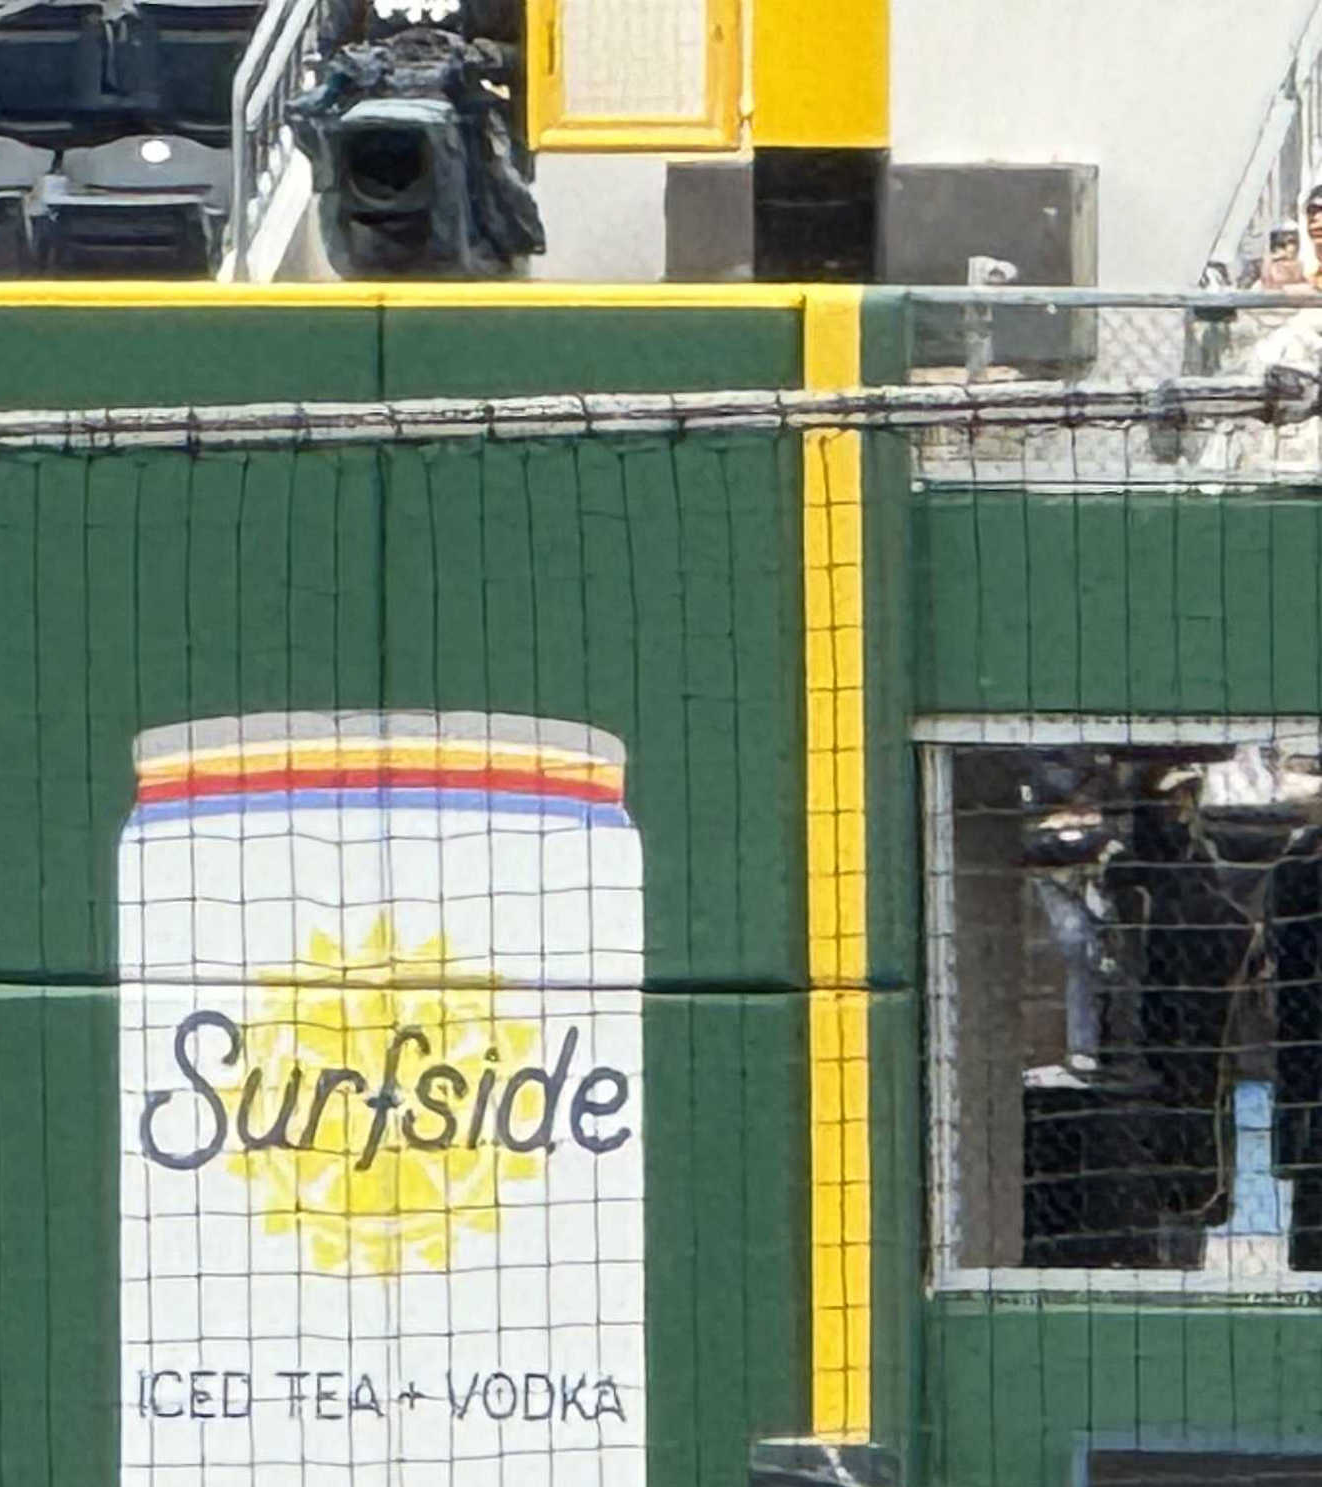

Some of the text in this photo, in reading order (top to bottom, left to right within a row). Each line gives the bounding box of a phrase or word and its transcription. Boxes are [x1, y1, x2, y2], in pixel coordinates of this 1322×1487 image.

[140, 1010, 631, 1172] Surfside
[137, 1370, 253, 1420] ICED
[275, 1370, 384, 1420] TEA
[445, 1370, 628, 1422] VODKA
